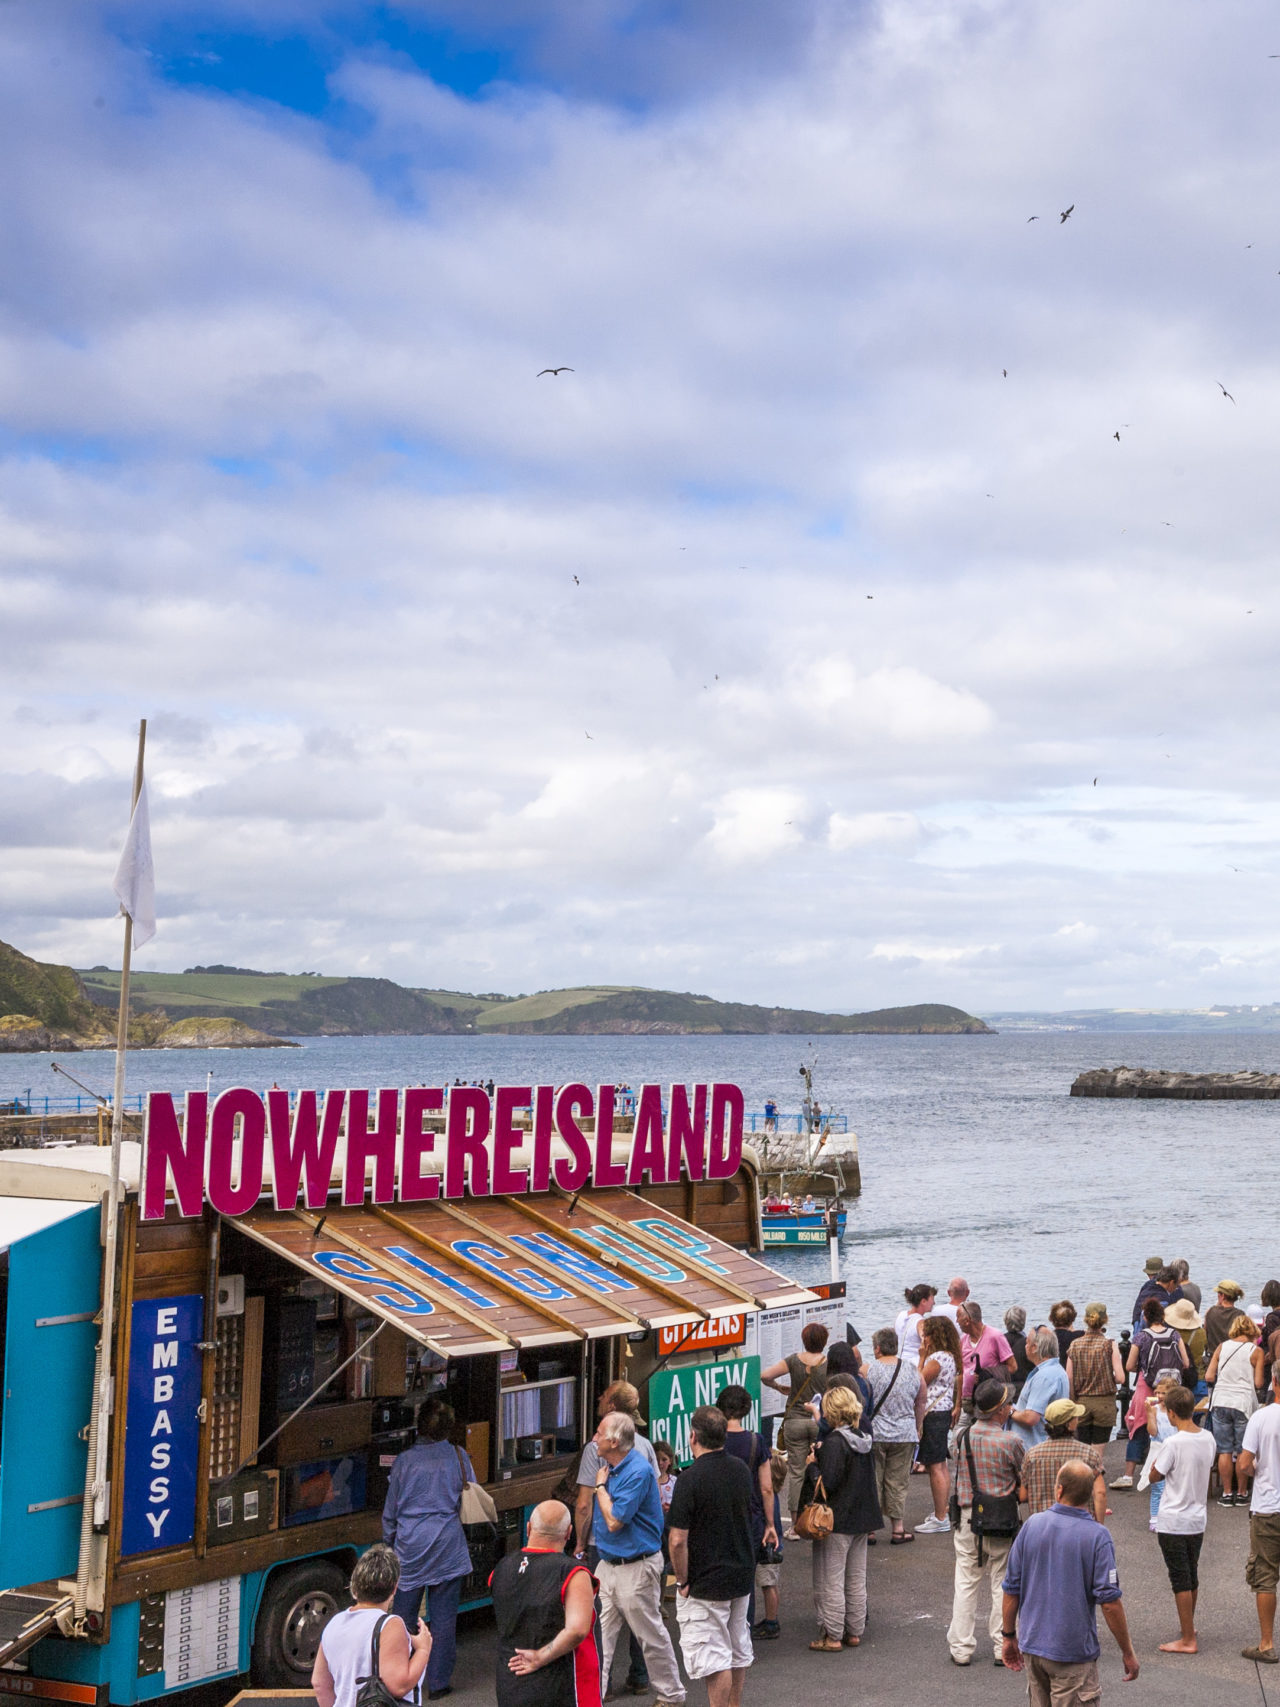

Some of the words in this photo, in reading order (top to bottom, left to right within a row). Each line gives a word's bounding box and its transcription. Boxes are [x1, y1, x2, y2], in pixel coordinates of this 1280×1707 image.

[139, 1081, 744, 1221] NOWHEREISLAND
[811, 1231, 827, 1241] MILES
[312, 1232, 640, 1316] SIGN
[568, 1217, 732, 1283] UP
[663, 1313, 740, 1345] CITIZENS
[668, 1374, 685, 1413] A
[695, 1362, 748, 1408] NEW
[146, 1307, 178, 1537] EMBASSY
[652, 1412, 694, 1463] ISLAN
